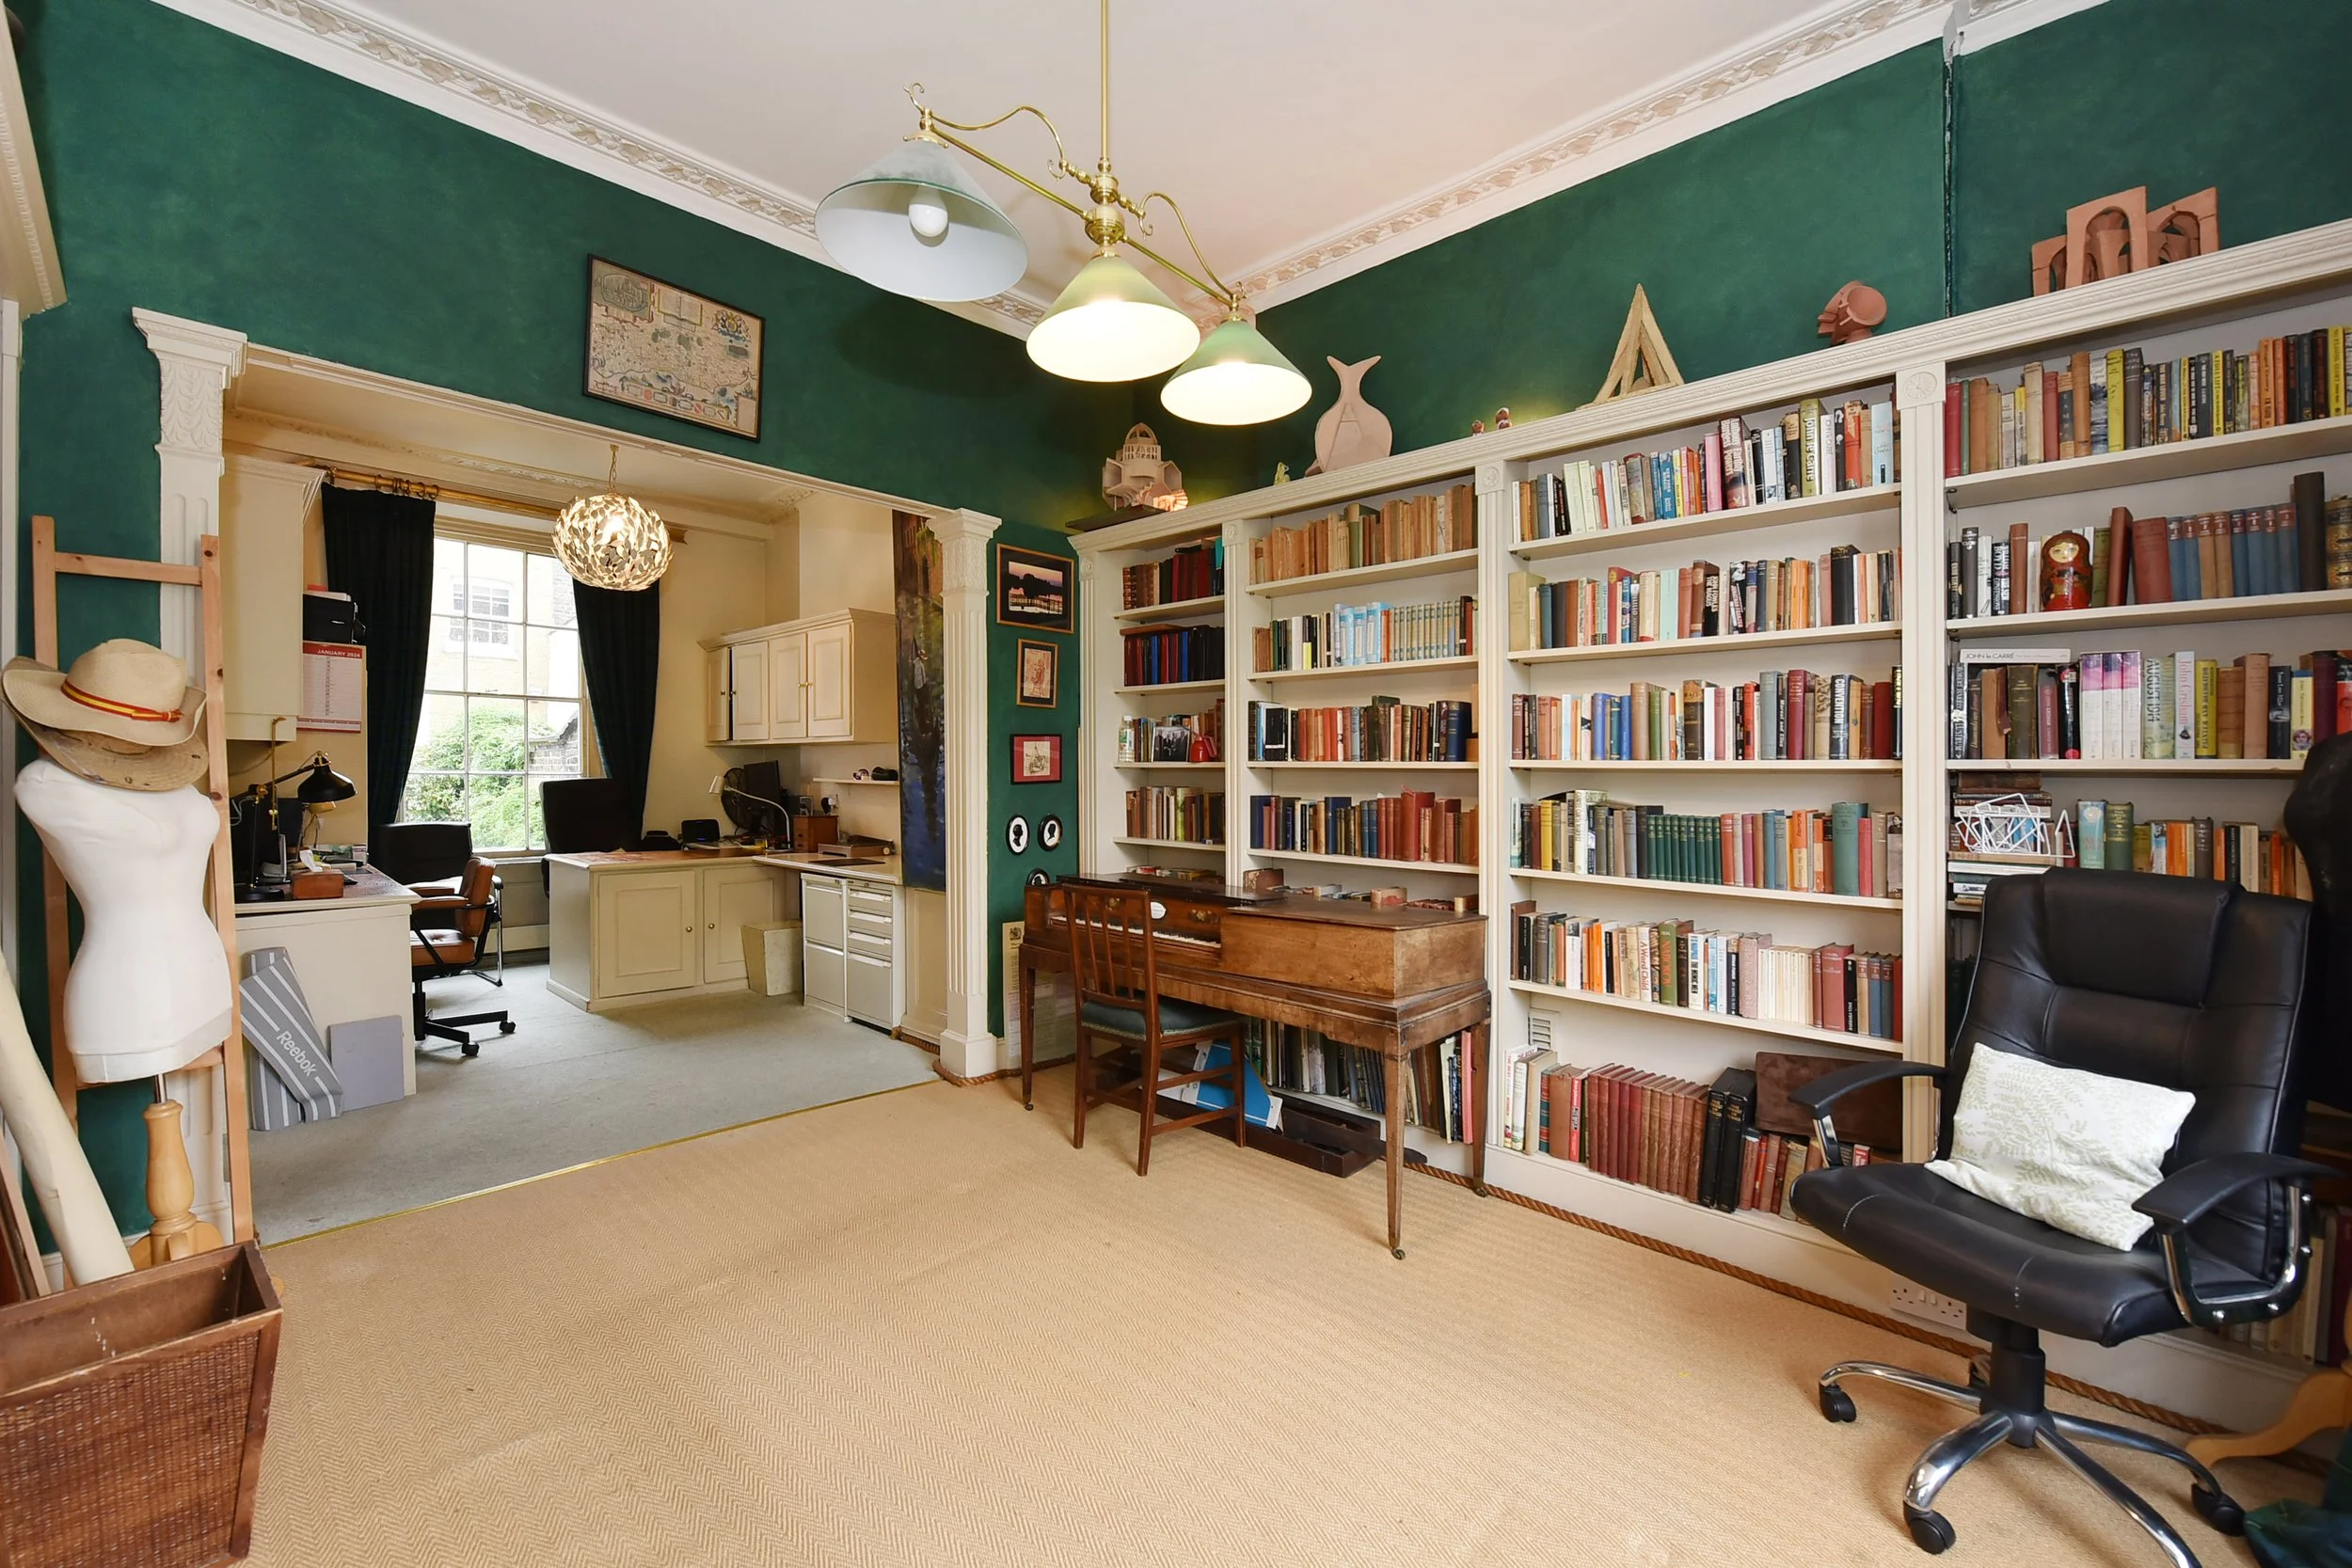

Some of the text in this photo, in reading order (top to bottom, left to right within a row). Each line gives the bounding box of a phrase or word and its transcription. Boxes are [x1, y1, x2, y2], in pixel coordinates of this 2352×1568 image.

[1721, 418, 1740, 448] Anthony Burgess
[1804, 418, 1816, 441] John
[1806, 442, 1815, 452] le
[1724, 449, 1735, 476] Powers
[1994, 546, 2002, 569] BOYD
[316, 649, 345, 657] JANUARY
[1834, 678, 1845, 724] CONVENTION
[2146, 660, 2161, 722] AUGUST 1914
[2178, 660, 2193, 724] John Grisham
[1955, 722, 1963, 751] LUSTRUM
[1640, 948, 1648, 970] Word
[1662, 940, 1672, 987] NABOKOV
[1641, 971, 1649, 990] Child
[1691, 969, 1699, 984] MIMIC
[1691, 985, 1699, 994] MEN
[276, 1030, 316, 1077] Reebok
